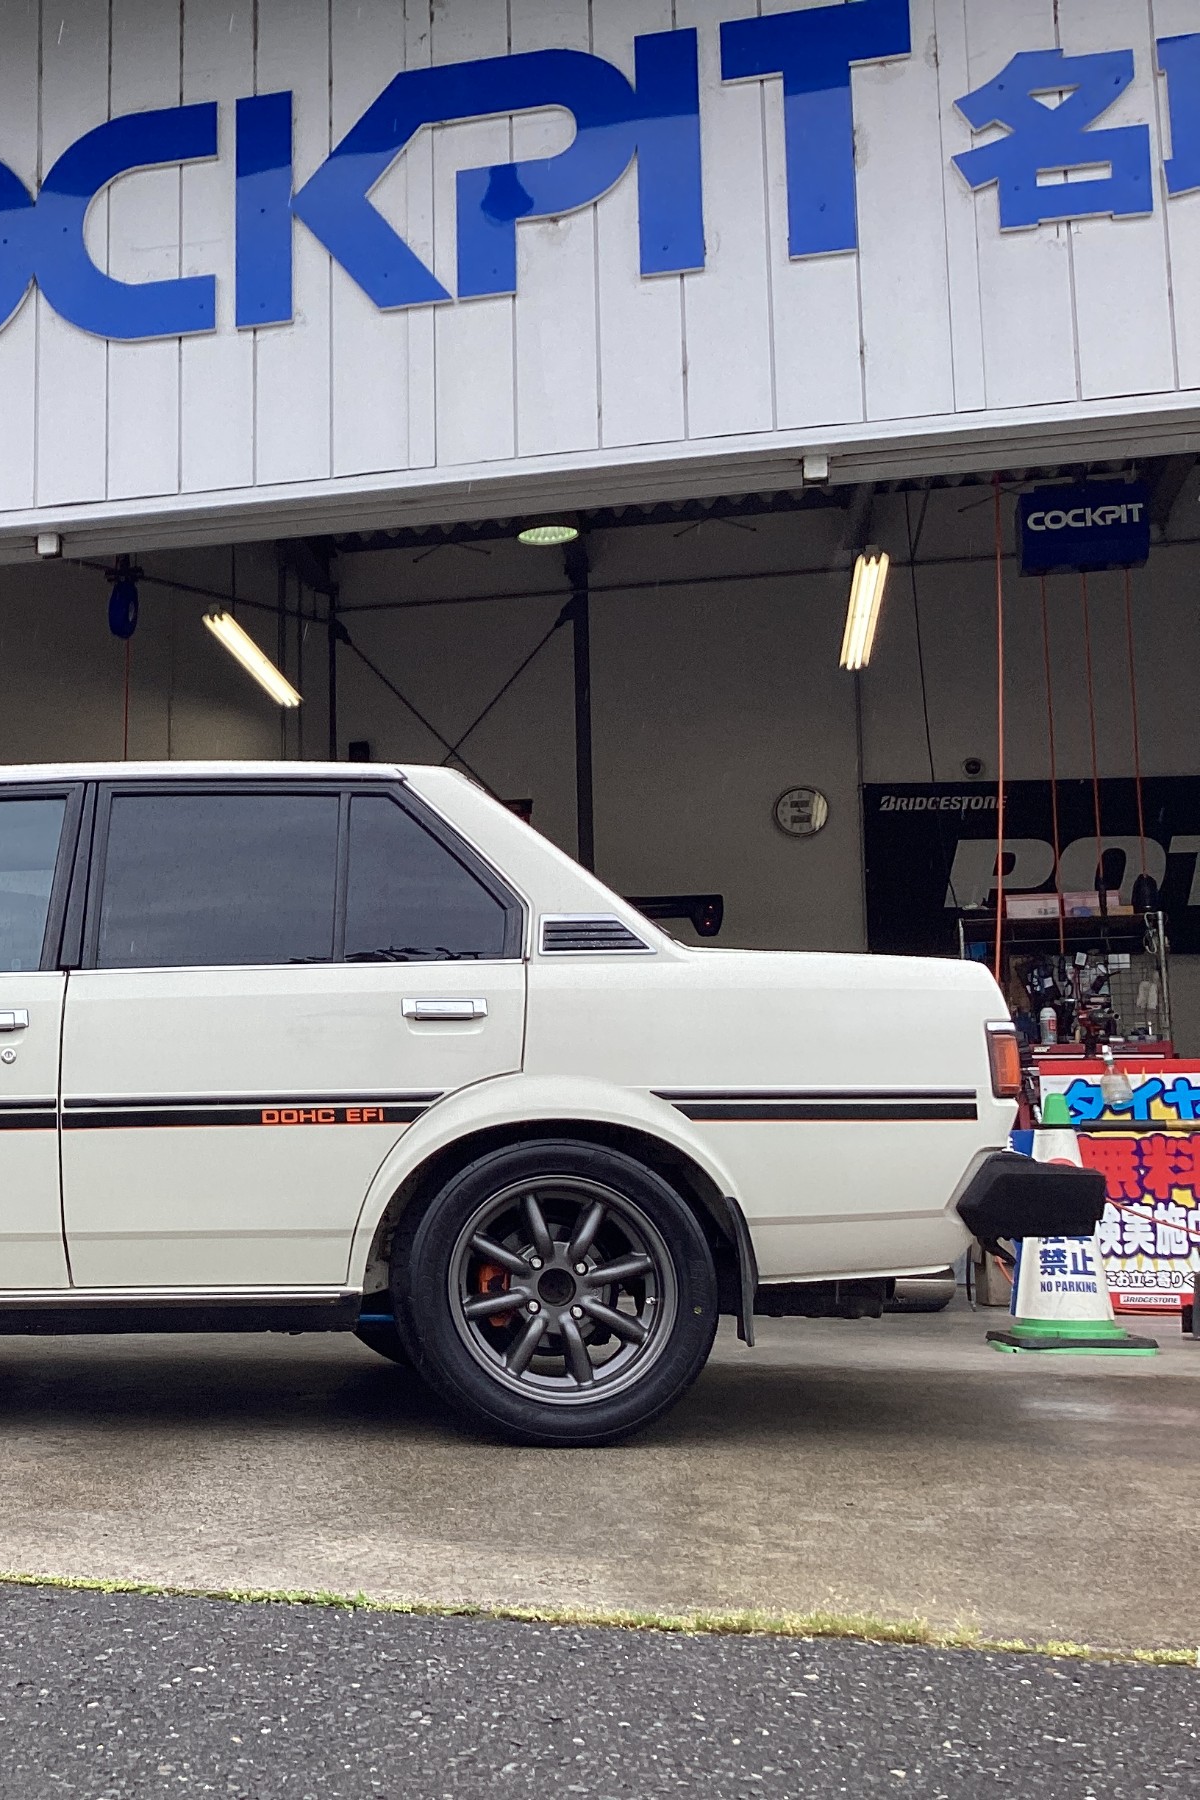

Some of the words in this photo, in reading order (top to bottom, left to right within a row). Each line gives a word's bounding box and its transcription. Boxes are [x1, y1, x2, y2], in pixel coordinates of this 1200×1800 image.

[1027, 503, 1144, 531] COCKPIT
[880, 796, 1007, 811] BRIDGESTONE
[262, 1109, 335, 1123] DOHC
[346, 1107, 384, 1122] EFI
[1039, 1248, 1096, 1276] 禁止
[1040, 1281, 1053, 1292] NO
[1055, 1281, 1098, 1293] PARKING
[1123, 1295, 1179, 1304] BRIDGESTONE
